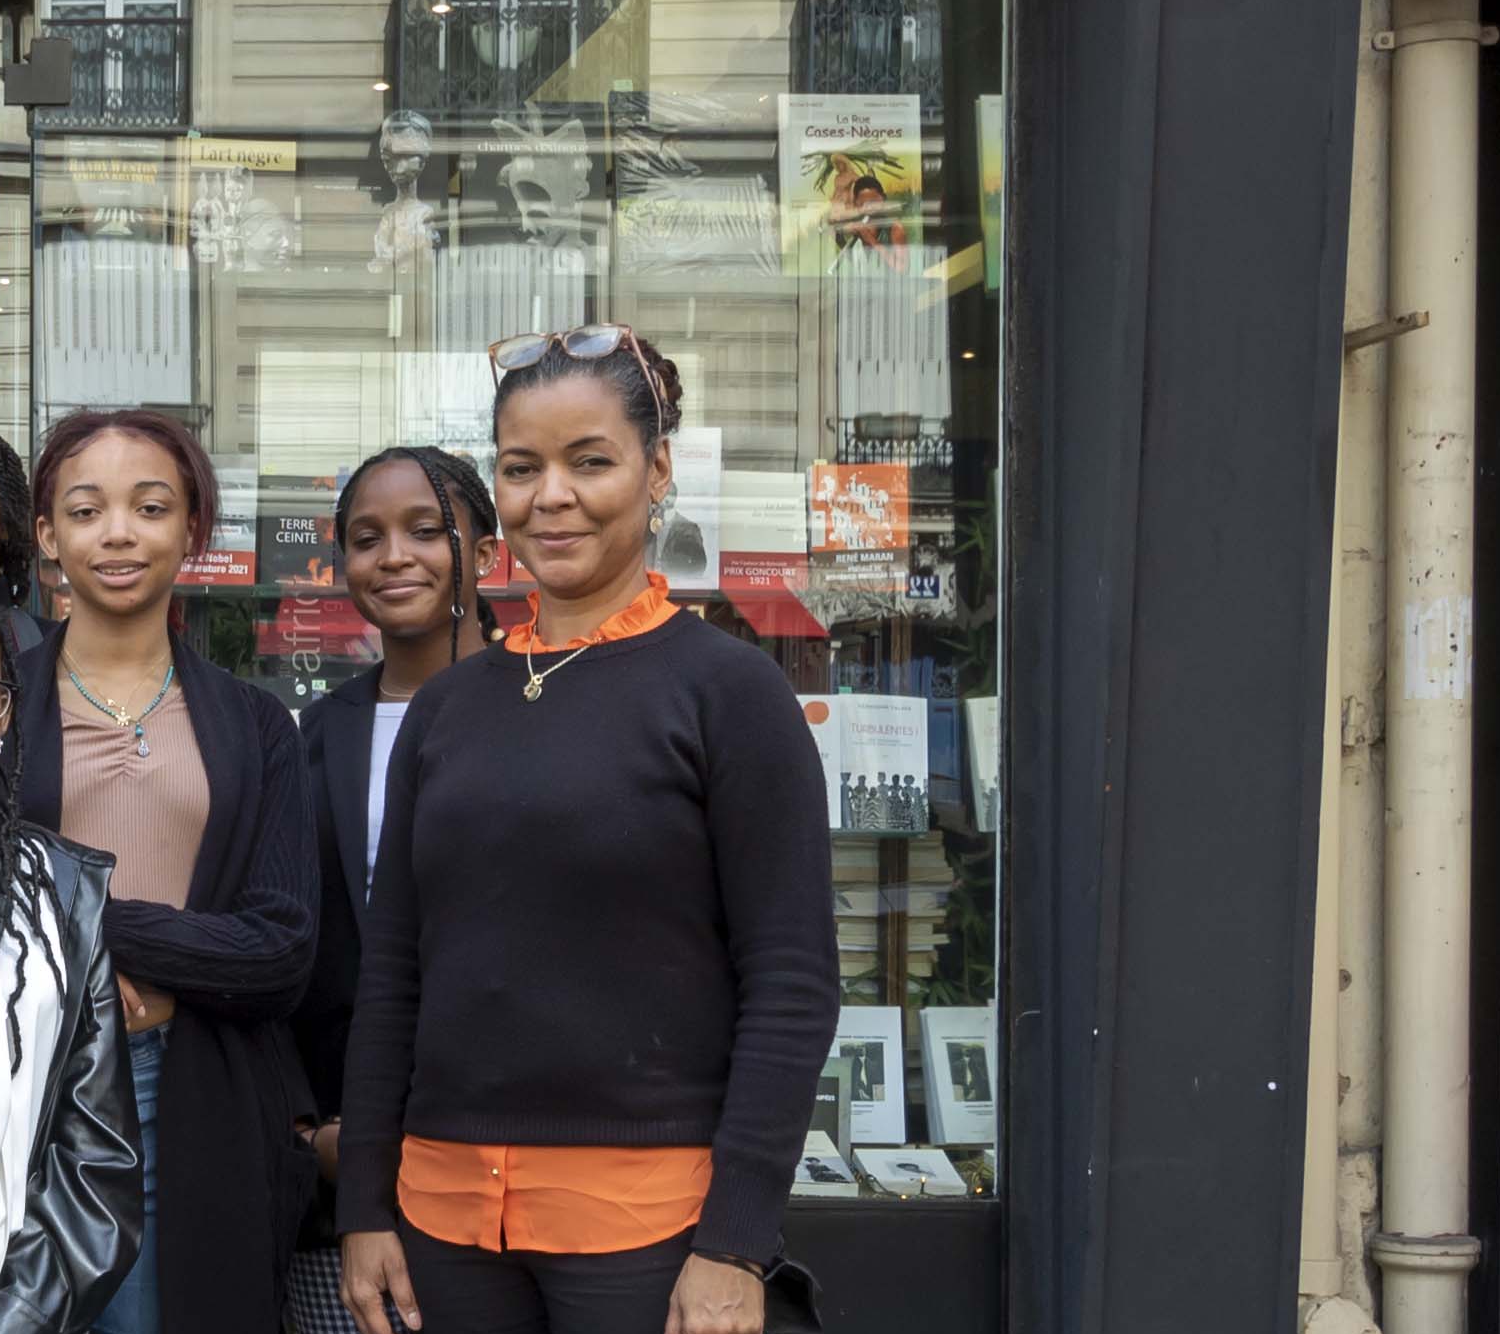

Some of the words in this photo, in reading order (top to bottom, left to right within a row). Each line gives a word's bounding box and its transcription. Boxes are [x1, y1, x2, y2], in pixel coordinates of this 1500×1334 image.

[836, 114, 848, 124] La
[851, 115, 870, 124] Rue
[805, 125, 902, 140] Cases-Nègres
[280, 518, 315, 531] TERRE
[276, 531, 317, 544] CEINTE
[205, 553, 232, 564] Nobel
[860, 551, 894, 562] MARAN
[228, 564, 248, 574] 2021
[724, 567, 743, 577] PRIX
[744, 567, 797, 578] GONCOURT
[749, 576, 771, 586] 1921
